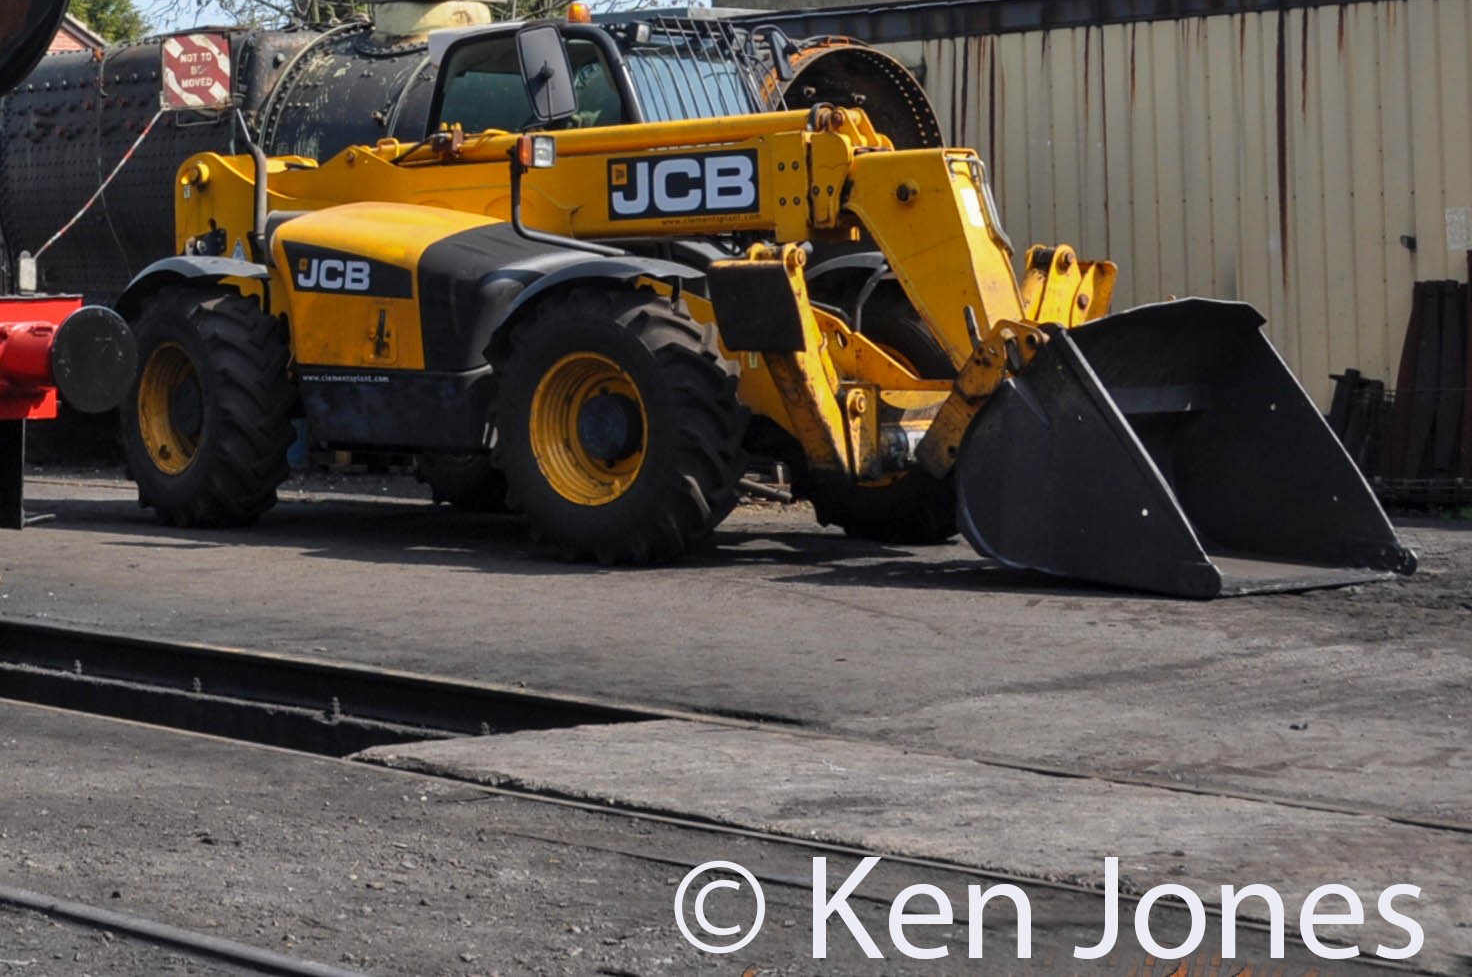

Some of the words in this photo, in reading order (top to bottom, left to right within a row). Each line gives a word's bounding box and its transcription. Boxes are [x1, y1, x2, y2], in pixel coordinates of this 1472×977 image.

[179, 53, 198, 63] NOT
[201, 52, 212, 62] TO
[181, 77, 214, 88] MOVED
[611, 154, 756, 215] JCB
[297, 258, 371, 291] JCB
